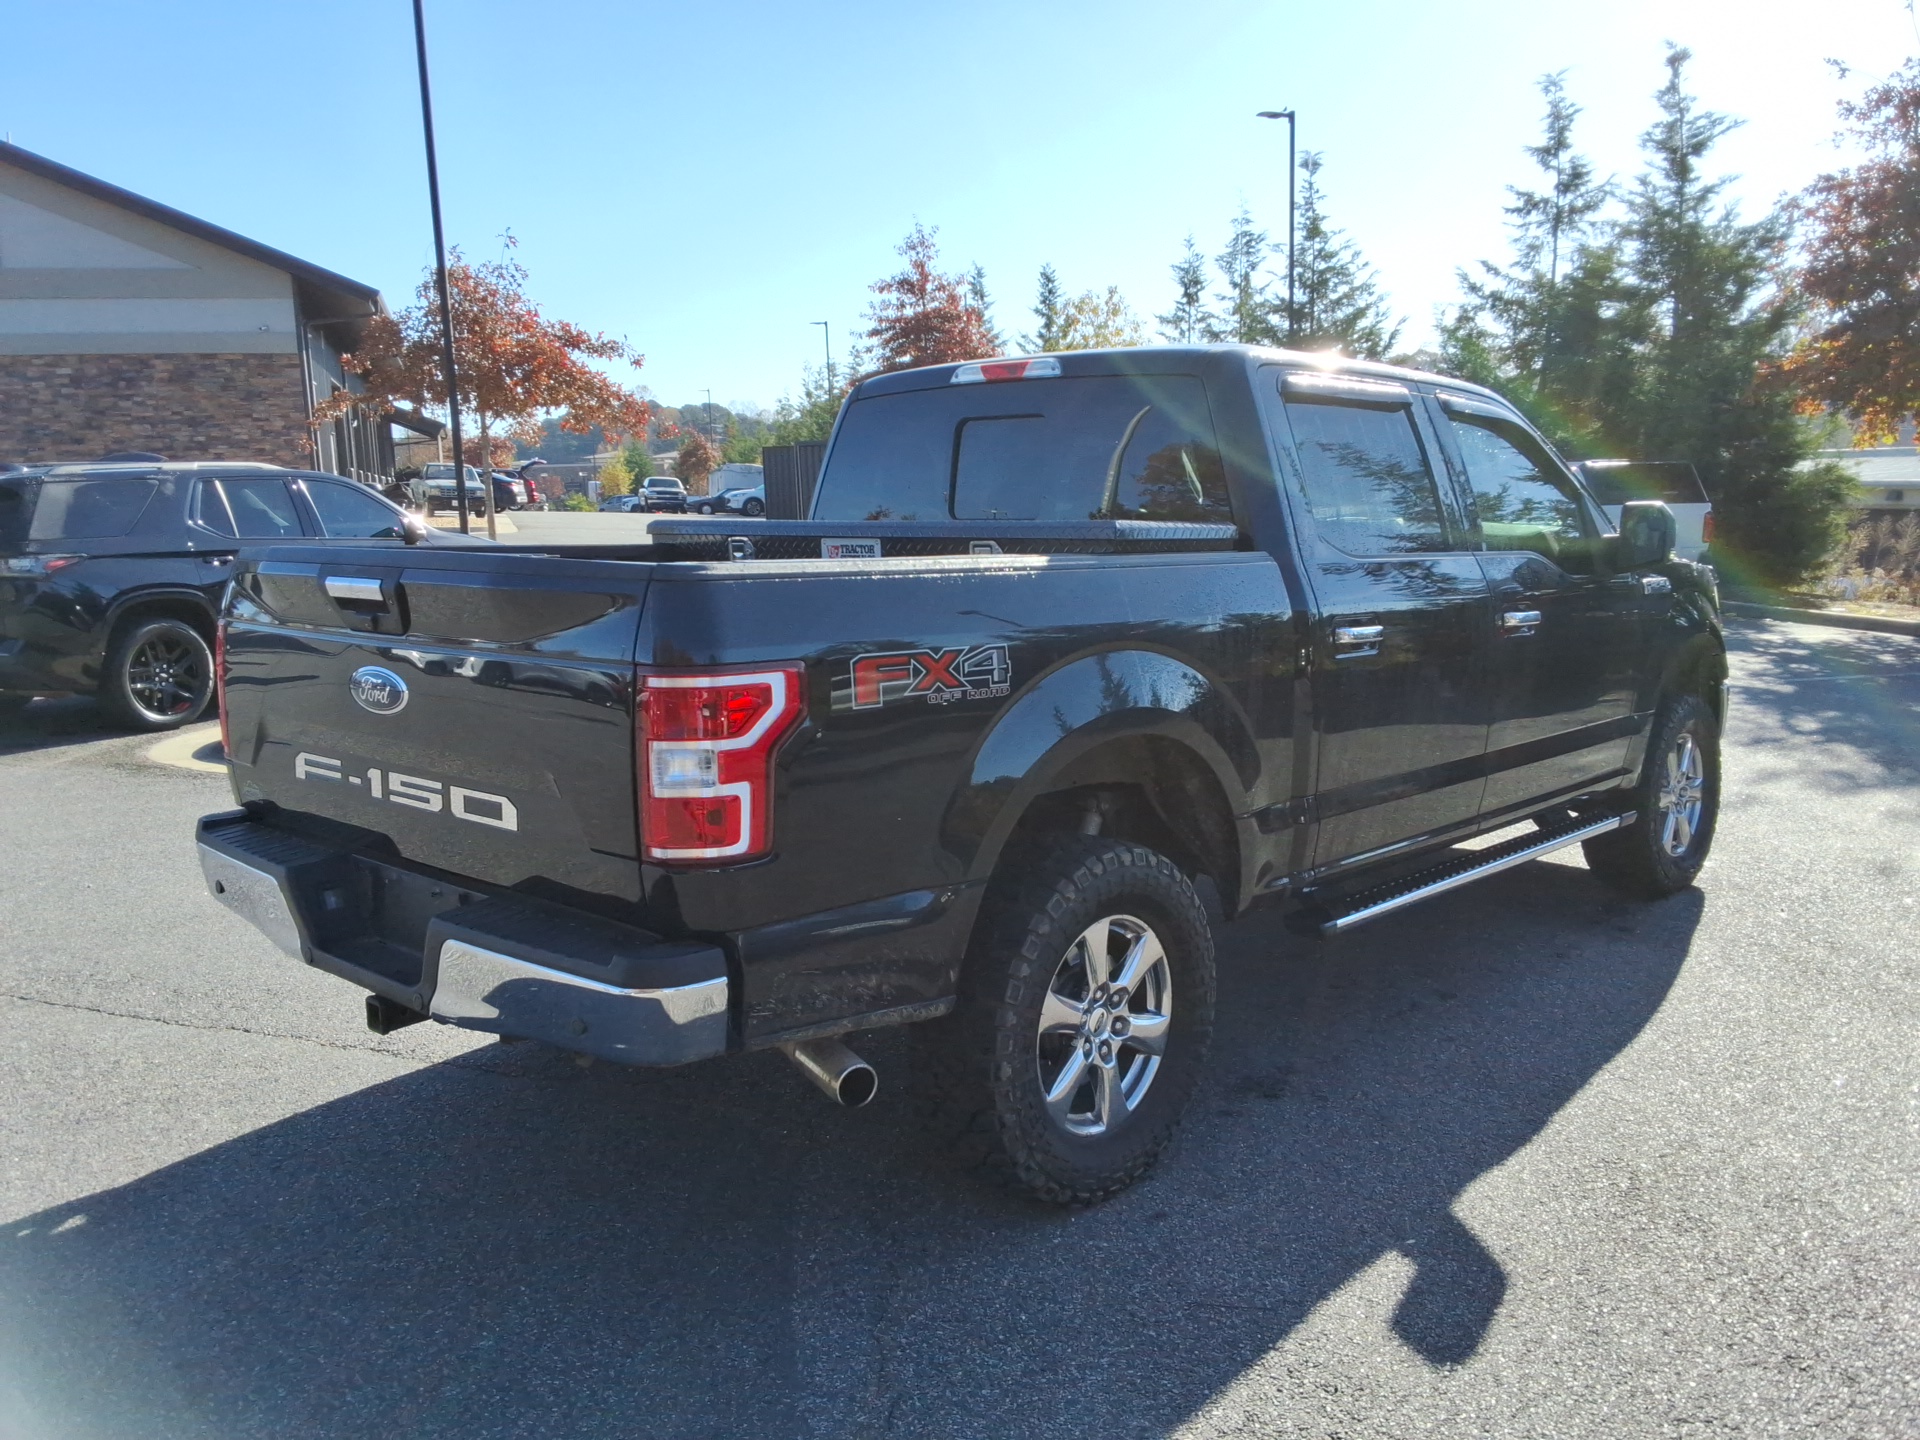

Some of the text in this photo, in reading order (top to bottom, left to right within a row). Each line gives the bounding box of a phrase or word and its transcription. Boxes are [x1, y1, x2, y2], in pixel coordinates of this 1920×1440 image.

[840, 544, 875, 554] TRACTOR
[360, 675, 391, 704] Ford
[850, 644, 1011, 709] FX4
[927, 686, 1011, 704] OFF ROAD
[295, 752, 518, 831] F-150
